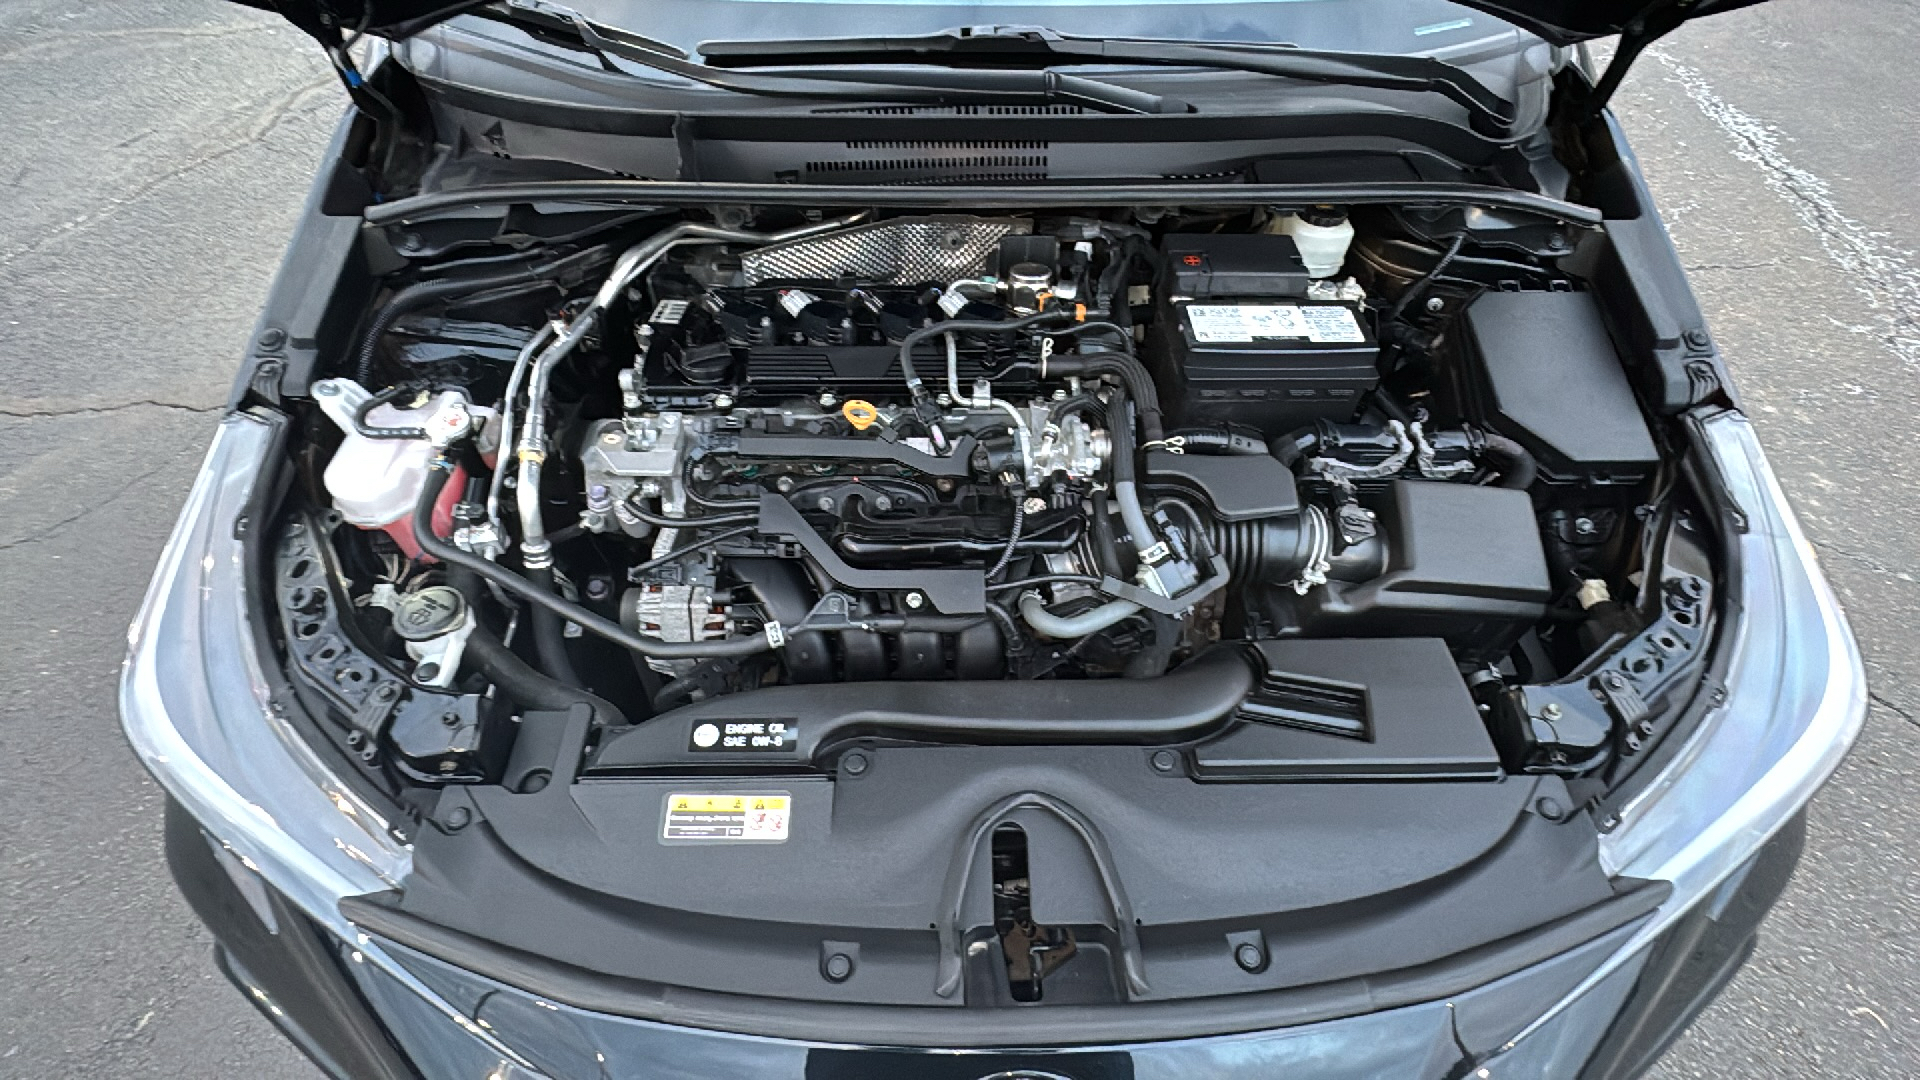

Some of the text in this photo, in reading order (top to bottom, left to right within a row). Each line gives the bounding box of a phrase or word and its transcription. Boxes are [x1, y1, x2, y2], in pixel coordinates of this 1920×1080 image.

[725, 723, 787, 734] ENGINE OIL
[723, 736, 747, 747] SAE
